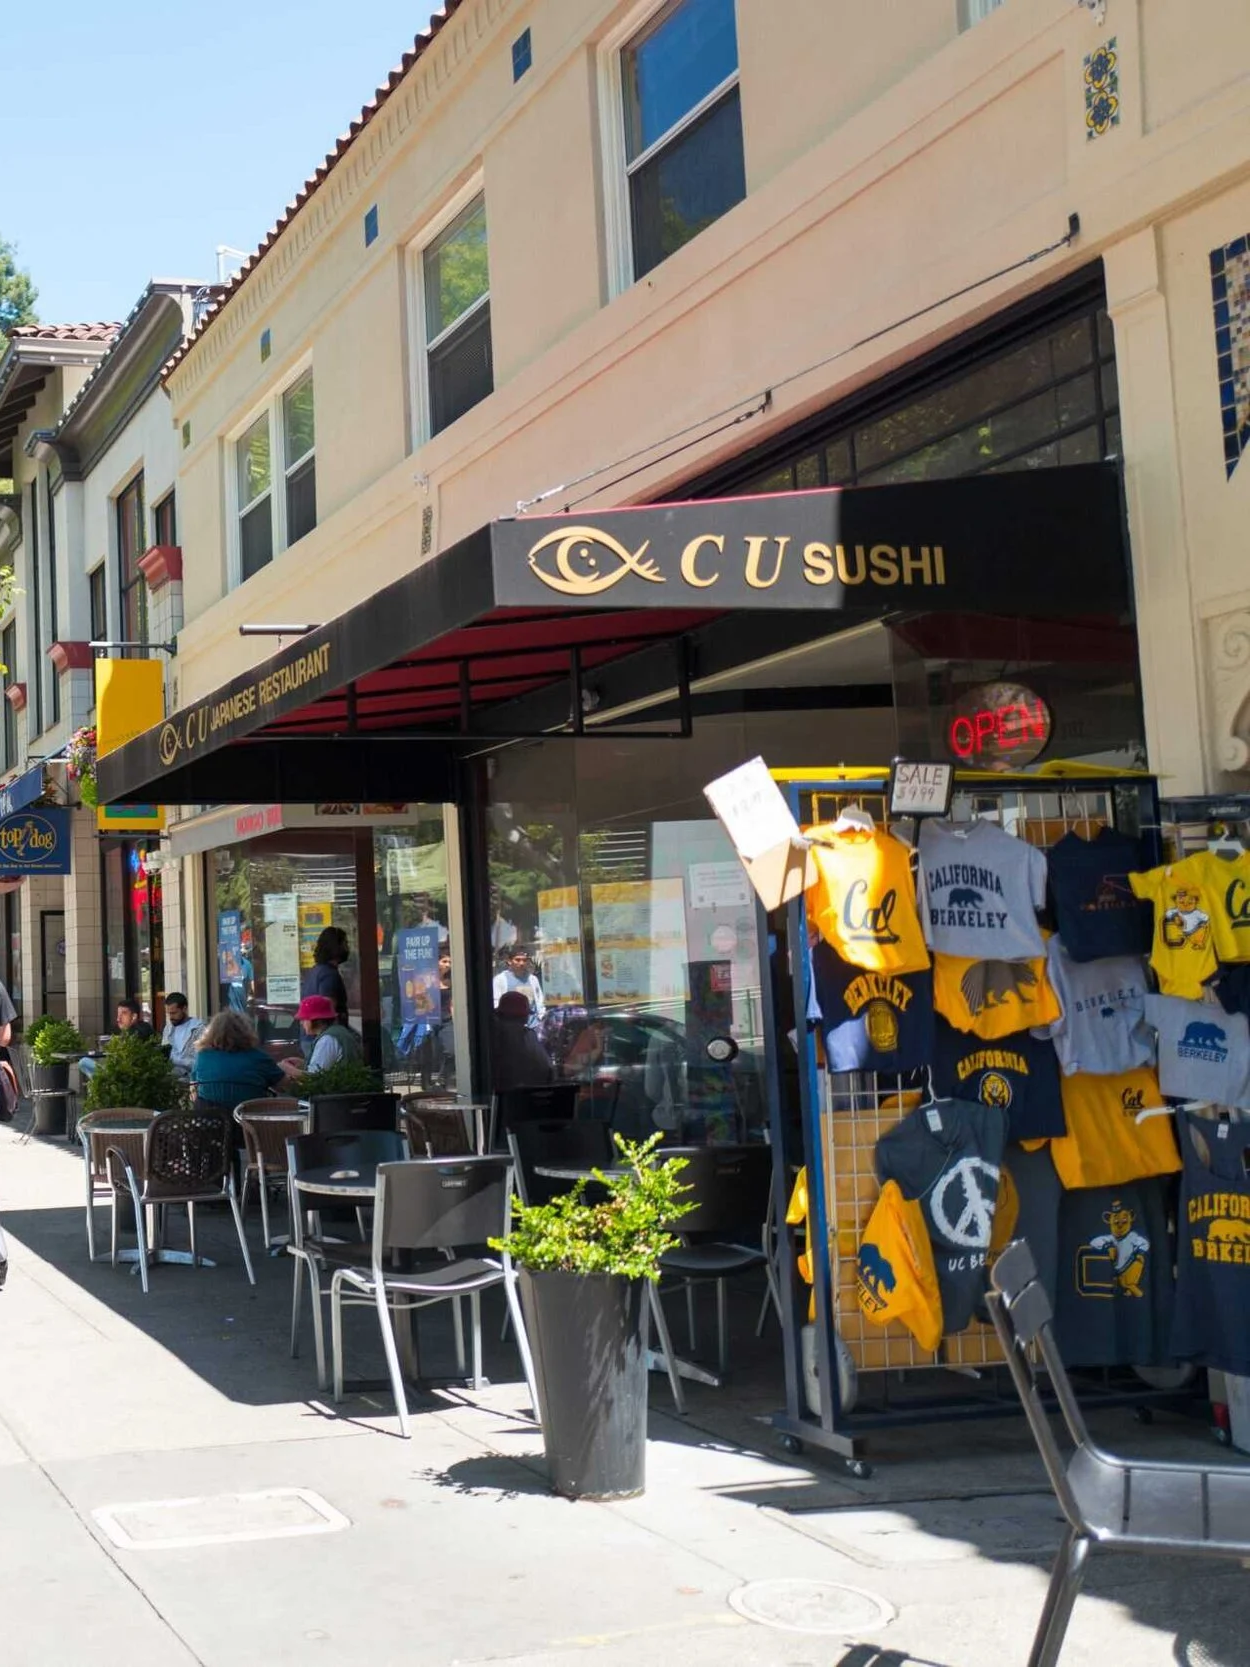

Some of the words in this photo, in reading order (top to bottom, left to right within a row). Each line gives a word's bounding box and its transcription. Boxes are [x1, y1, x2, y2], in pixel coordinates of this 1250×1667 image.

[802, 542, 946, 586] SUSHI
[210, 686, 256, 731] JAPANESE
[259, 643, 332, 707] RESTAURANT
[950, 698, 1045, 757] OPEN
[896, 764, 944, 786] SALE
[0, 827, 23, 850] top
[29, 827, 54, 850] dog
[929, 865, 1004, 895] CALIFORNIA
[843, 879, 900, 943] Cal
[930, 907, 1009, 929] BERKELEY
[956, 1049, 1029, 1081] CALIFORNIA
[1177, 1046, 1229, 1064] BERKELEY
[1121, 1087, 1145, 1109] Cal
[948, 1258, 966, 1272] UC
